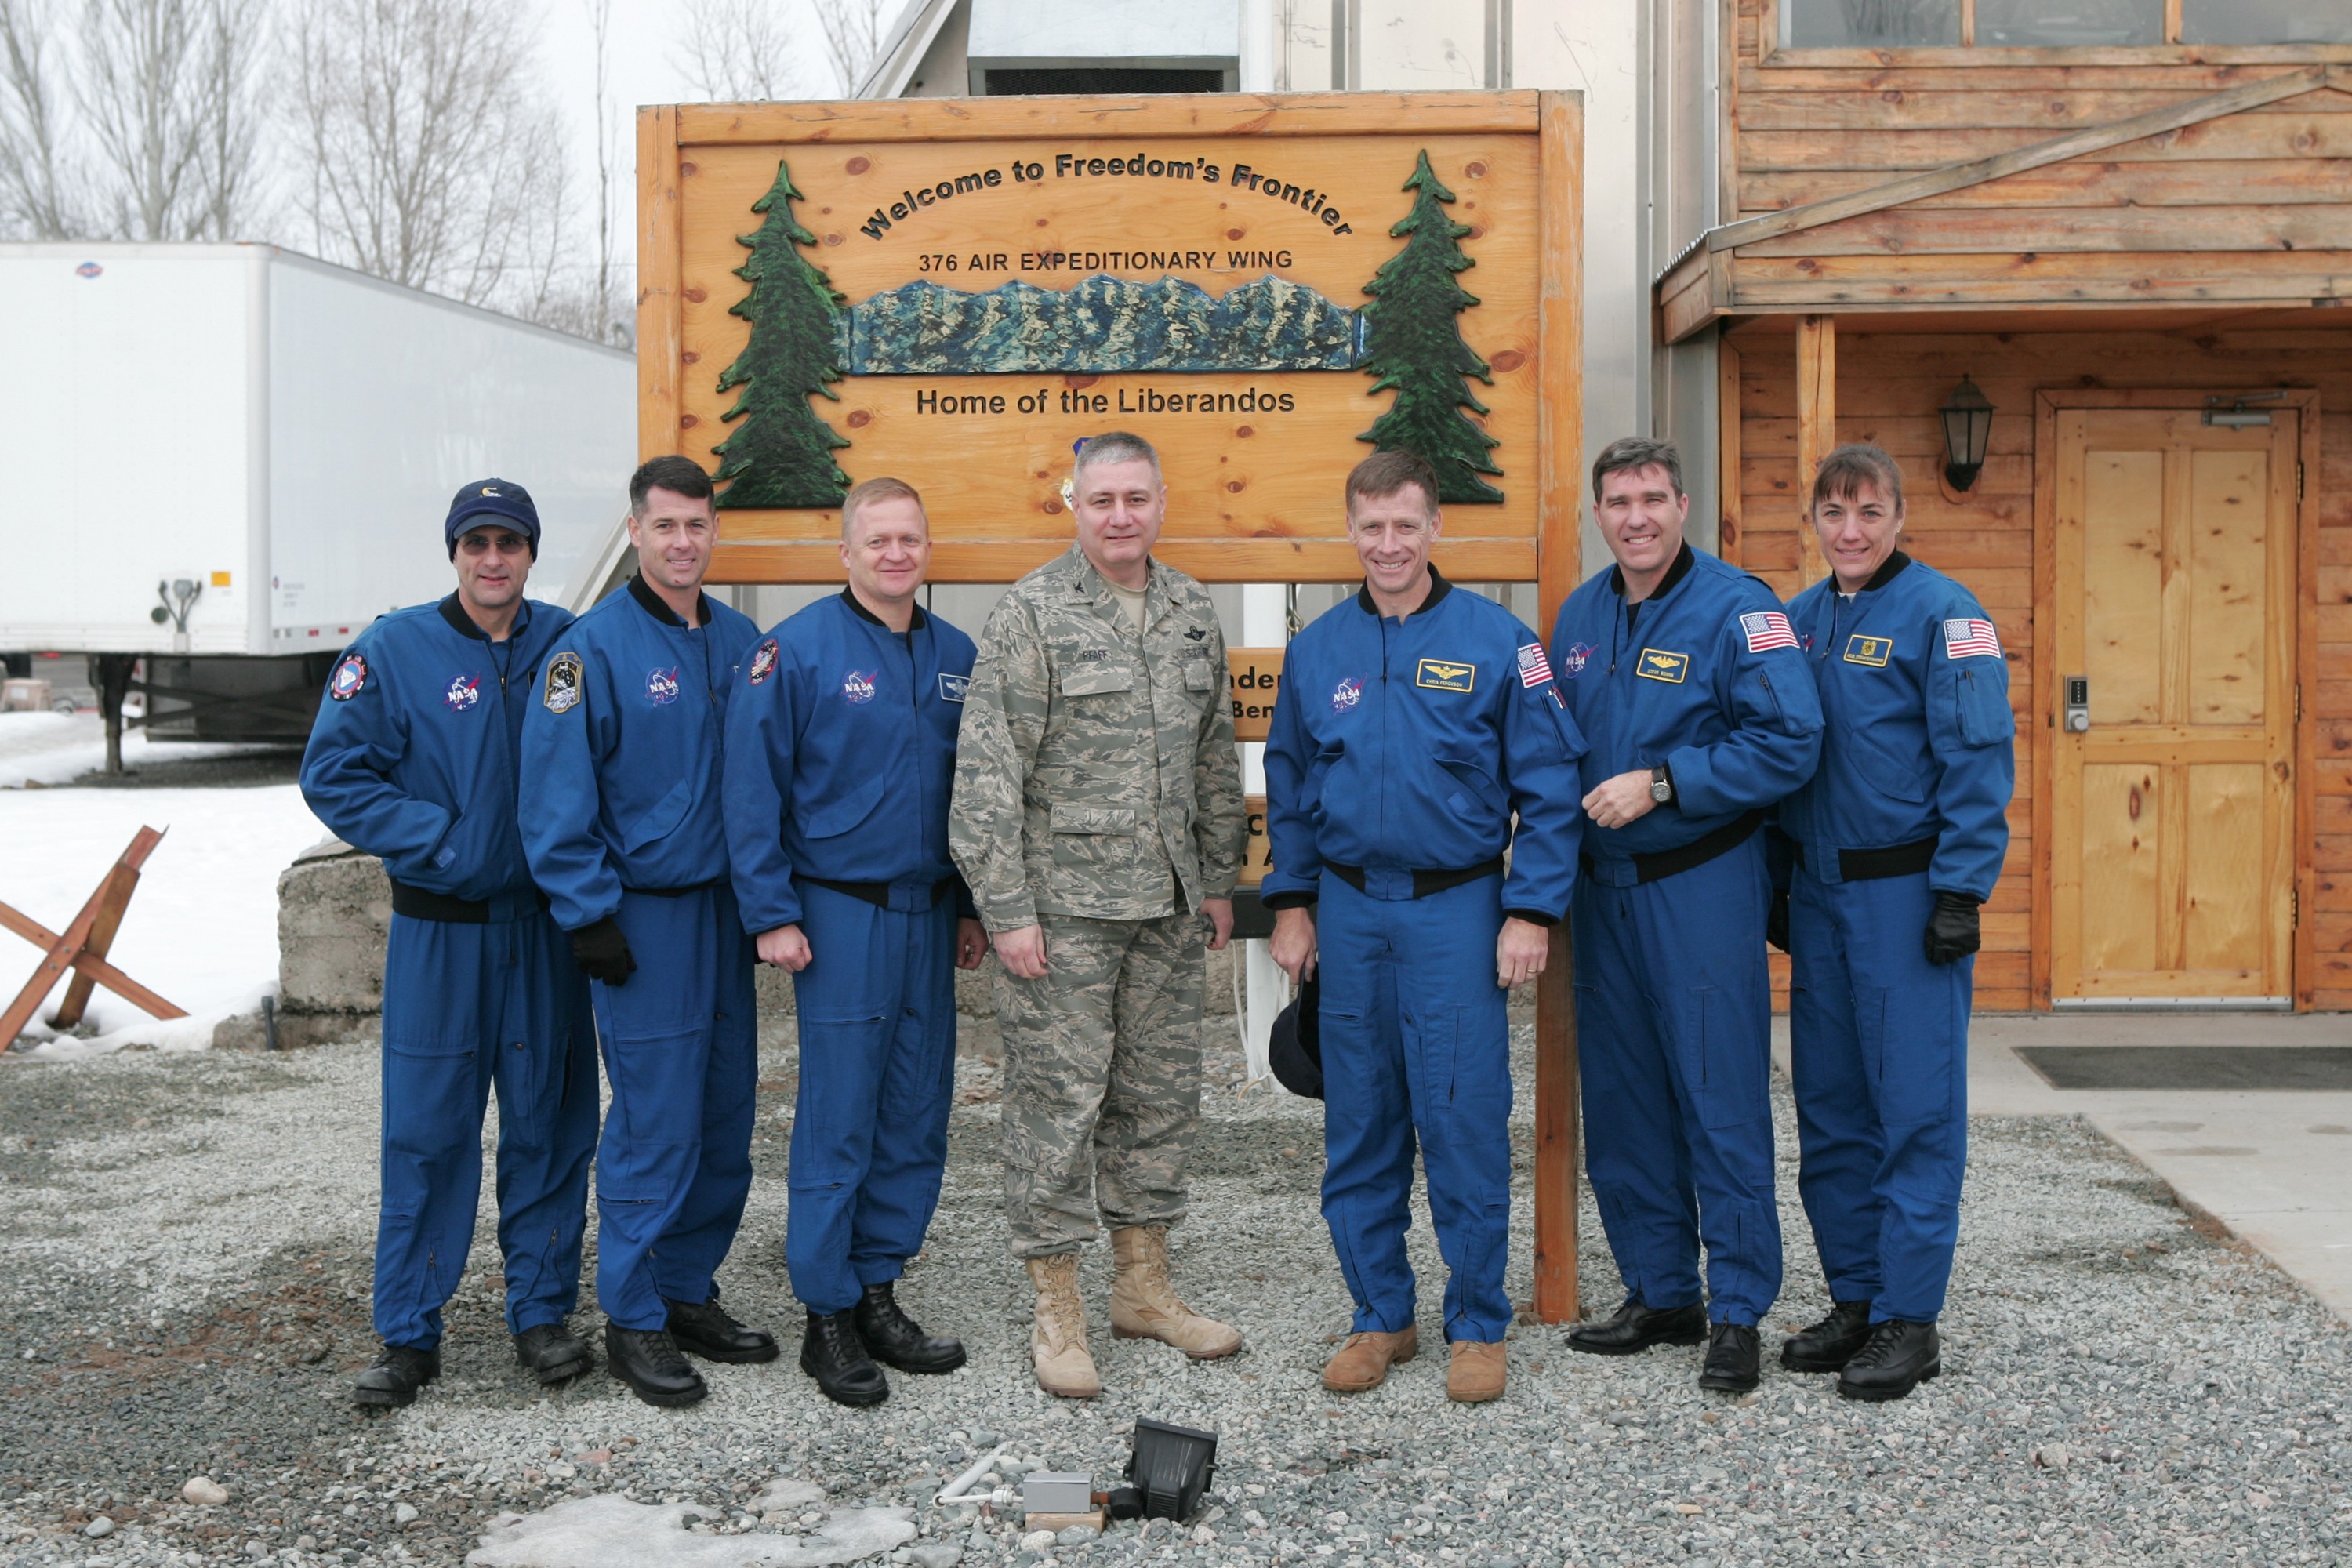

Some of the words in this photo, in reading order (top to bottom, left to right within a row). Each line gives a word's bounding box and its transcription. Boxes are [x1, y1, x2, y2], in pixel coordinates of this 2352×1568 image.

[859, 169, 1002, 241] Welcome
[1011, 160, 1044, 183] to
[1055, 152, 1220, 183] Freedom's
[1231, 163, 1353, 236] Frontier
[919, 254, 958, 272] 376
[968, 253, 1008, 271] AIR
[1021, 251, 1217, 270] EXPEDITIONARY
[1227, 250, 1292, 269] WING
[917, 390, 1006, 415] Home
[1017, 388, 1049, 414] of
[1059, 388, 1109, 414] the
[1118, 387, 1295, 413] Liberandos
[649, 680, 678, 694] NASA
[844, 682, 875, 693] NASA
[448, 688, 478, 702] NASA
[1334, 688, 1360, 703] NASA
